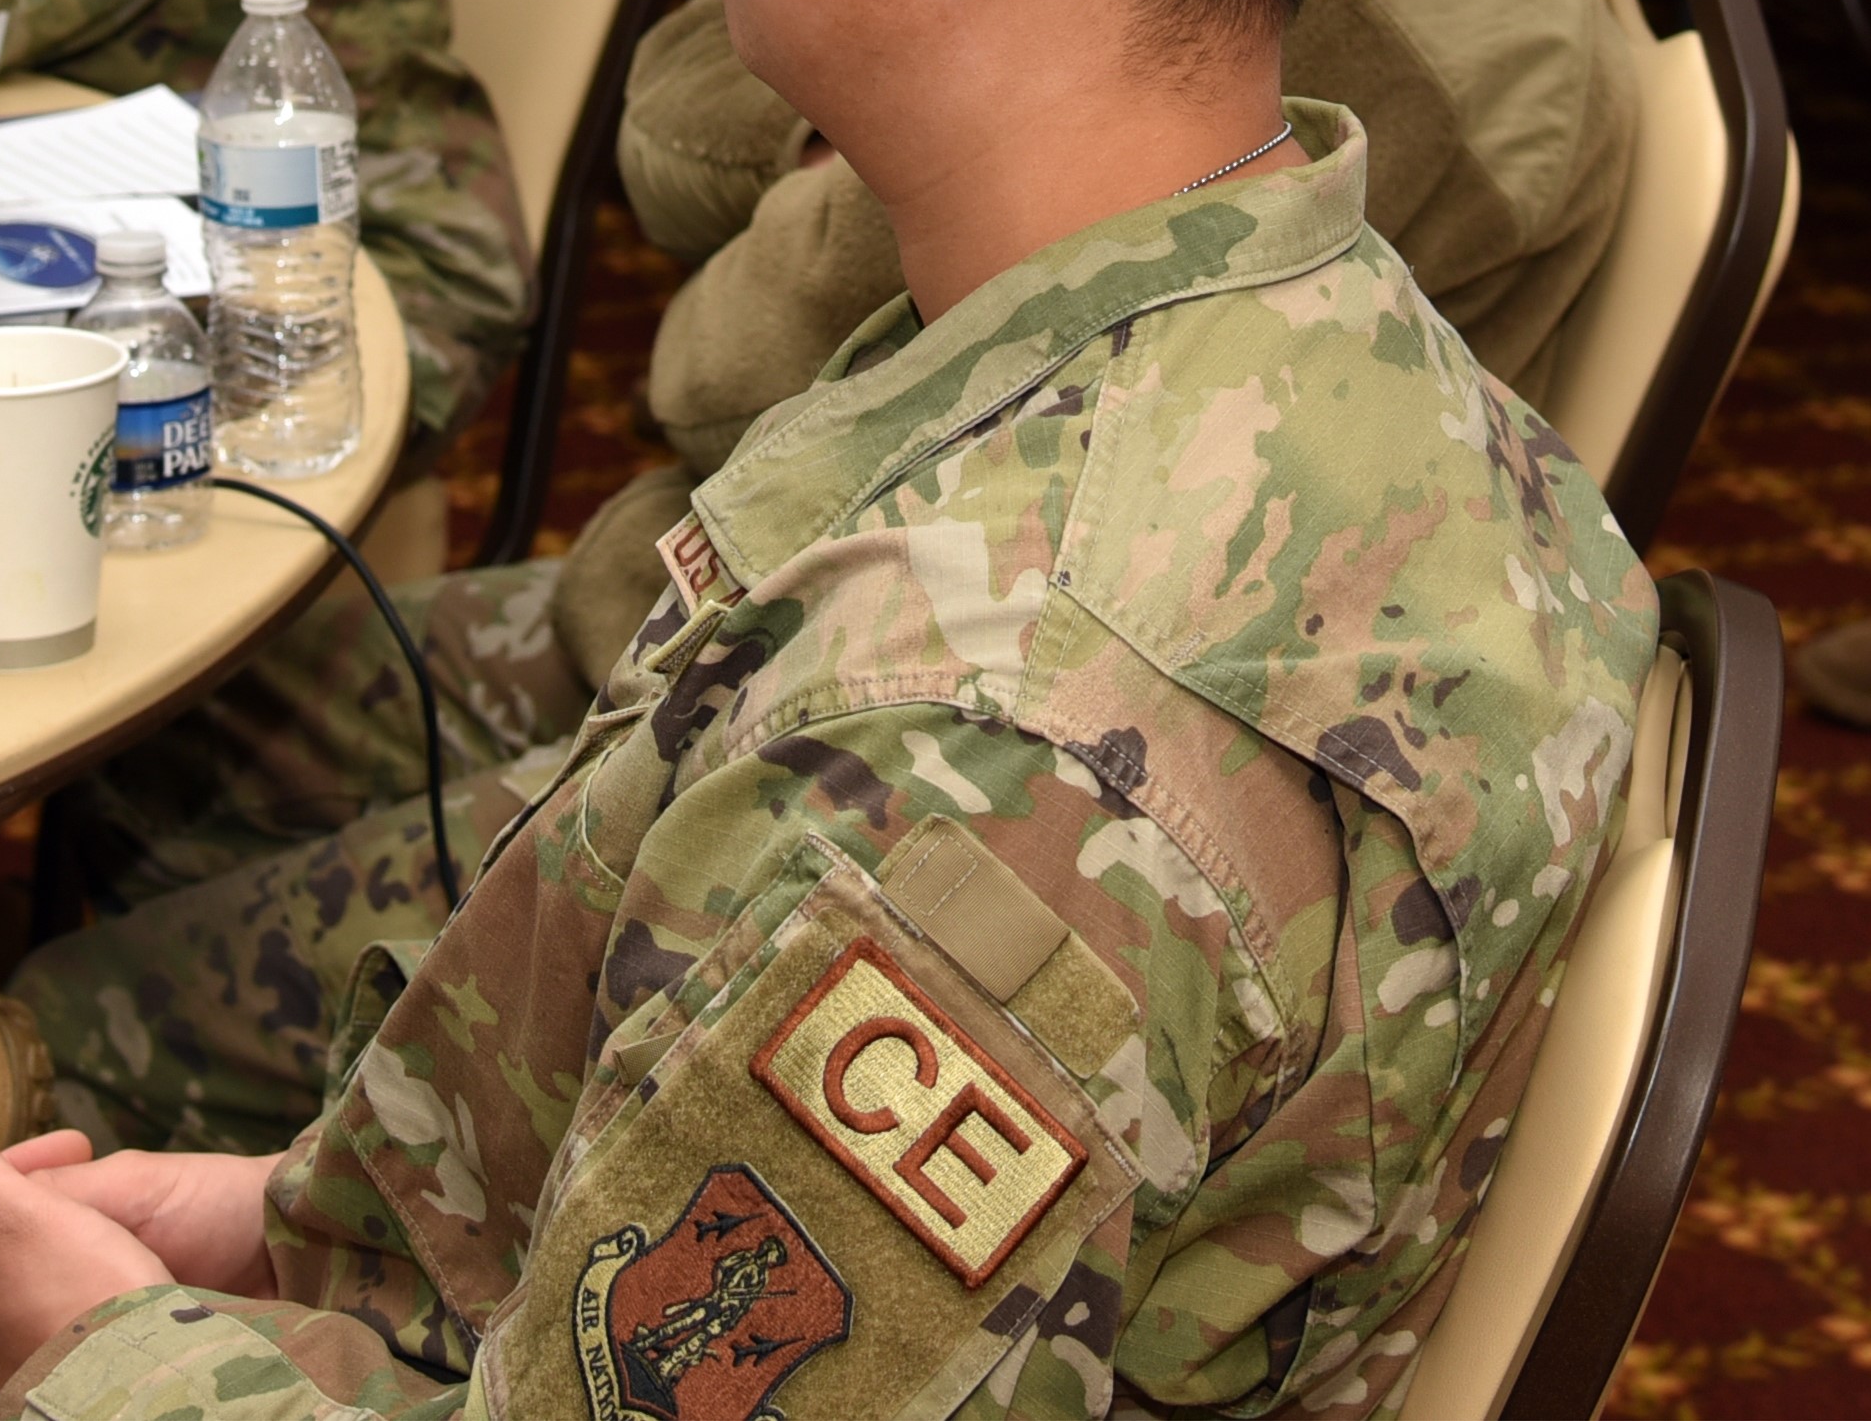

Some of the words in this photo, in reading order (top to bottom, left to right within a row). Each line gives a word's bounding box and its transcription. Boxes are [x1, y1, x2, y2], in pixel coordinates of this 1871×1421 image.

[163, 441, 210, 478] PAR
[823, 1016, 1033, 1229] CE
[581, 1287, 600, 1334] AIR
